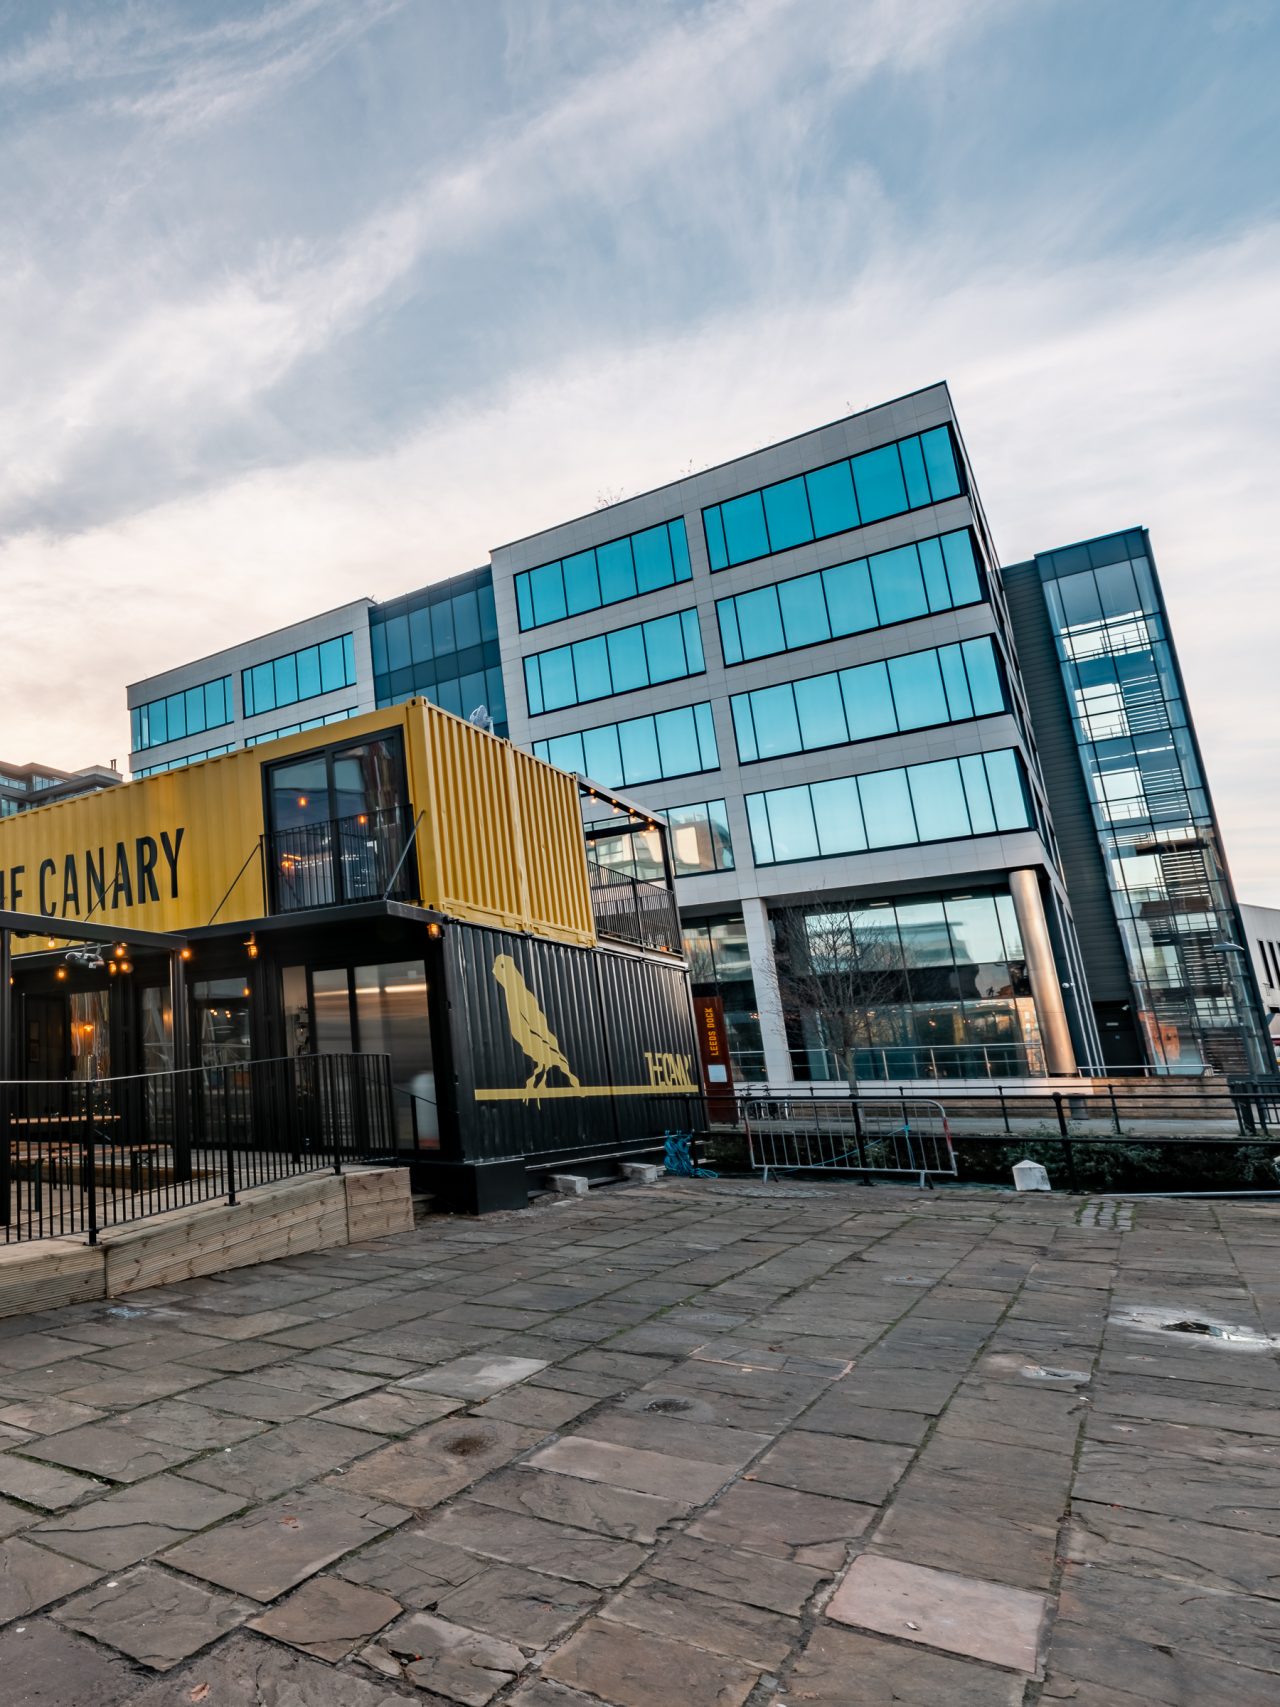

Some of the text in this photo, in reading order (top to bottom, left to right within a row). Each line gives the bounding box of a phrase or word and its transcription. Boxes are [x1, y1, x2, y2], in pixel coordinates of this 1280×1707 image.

[39, 828, 185, 918] CANARY
[704, 1007, 719, 1056] LEEDS DOCK
